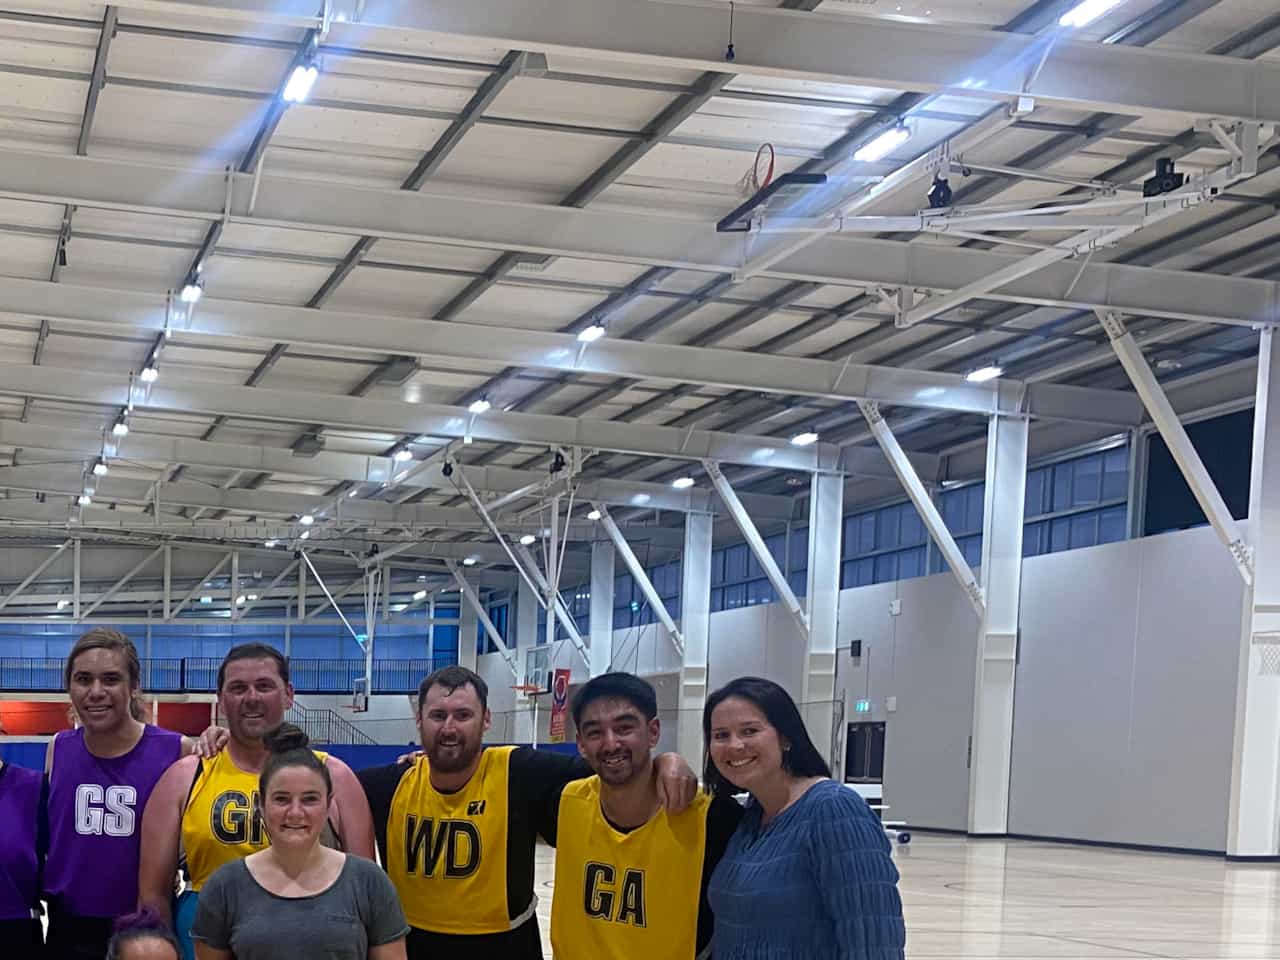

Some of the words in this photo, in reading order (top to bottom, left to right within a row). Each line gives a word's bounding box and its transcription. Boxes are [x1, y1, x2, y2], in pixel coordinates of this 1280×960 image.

[74, 783, 138, 837] GS
[403, 813, 482, 880] WD
[582, 860, 648, 929] GA
